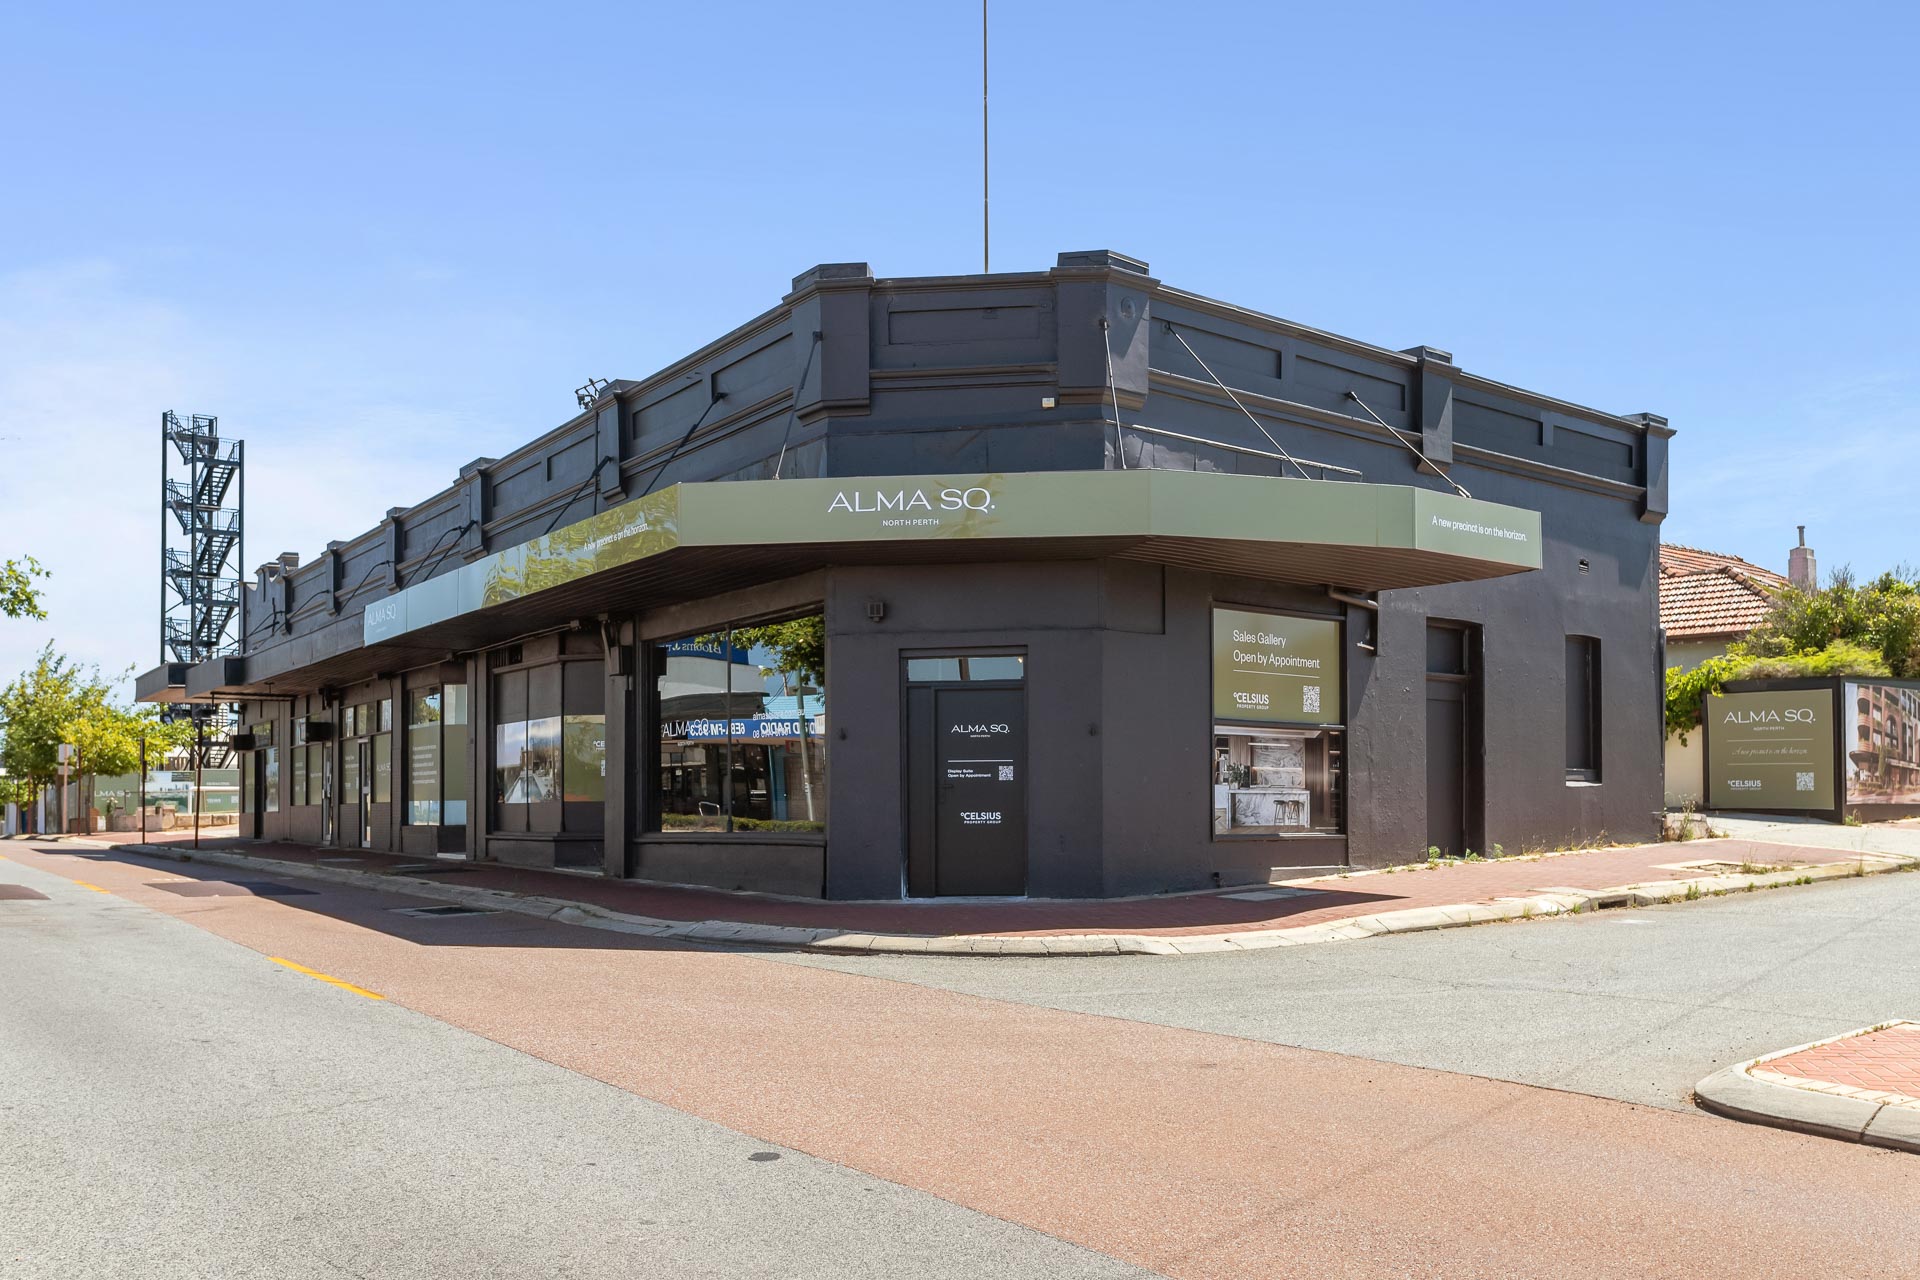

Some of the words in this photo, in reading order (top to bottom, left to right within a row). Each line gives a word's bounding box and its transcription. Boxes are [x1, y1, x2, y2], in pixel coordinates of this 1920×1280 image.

[827, 488, 932, 512] ALMA
[940, 487, 996, 514] SQ.
[1432, 515, 1438, 525] A
[1438, 518, 1452, 528] new
[1452, 521, 1478, 533] precinct
[1478, 524, 1484, 534] is
[1485, 527, 1493, 536] on
[1494, 527, 1504, 538] the
[368, 608, 386, 626] ALMA
[1233, 630, 1256, 644] Sales
[1257, 632, 1286, 648] Gallery
[1233, 650, 1256, 664] Open
[1257, 653, 1267, 666] by
[1268, 653, 1320, 669] Appointment
[1724, 710, 1780, 724] ALMA
[1784, 708, 1816, 724] SQ.
[662, 721, 690, 738] ALMA
[951, 724, 988, 733] ALMA
[990, 724, 1010, 733] SQ.
